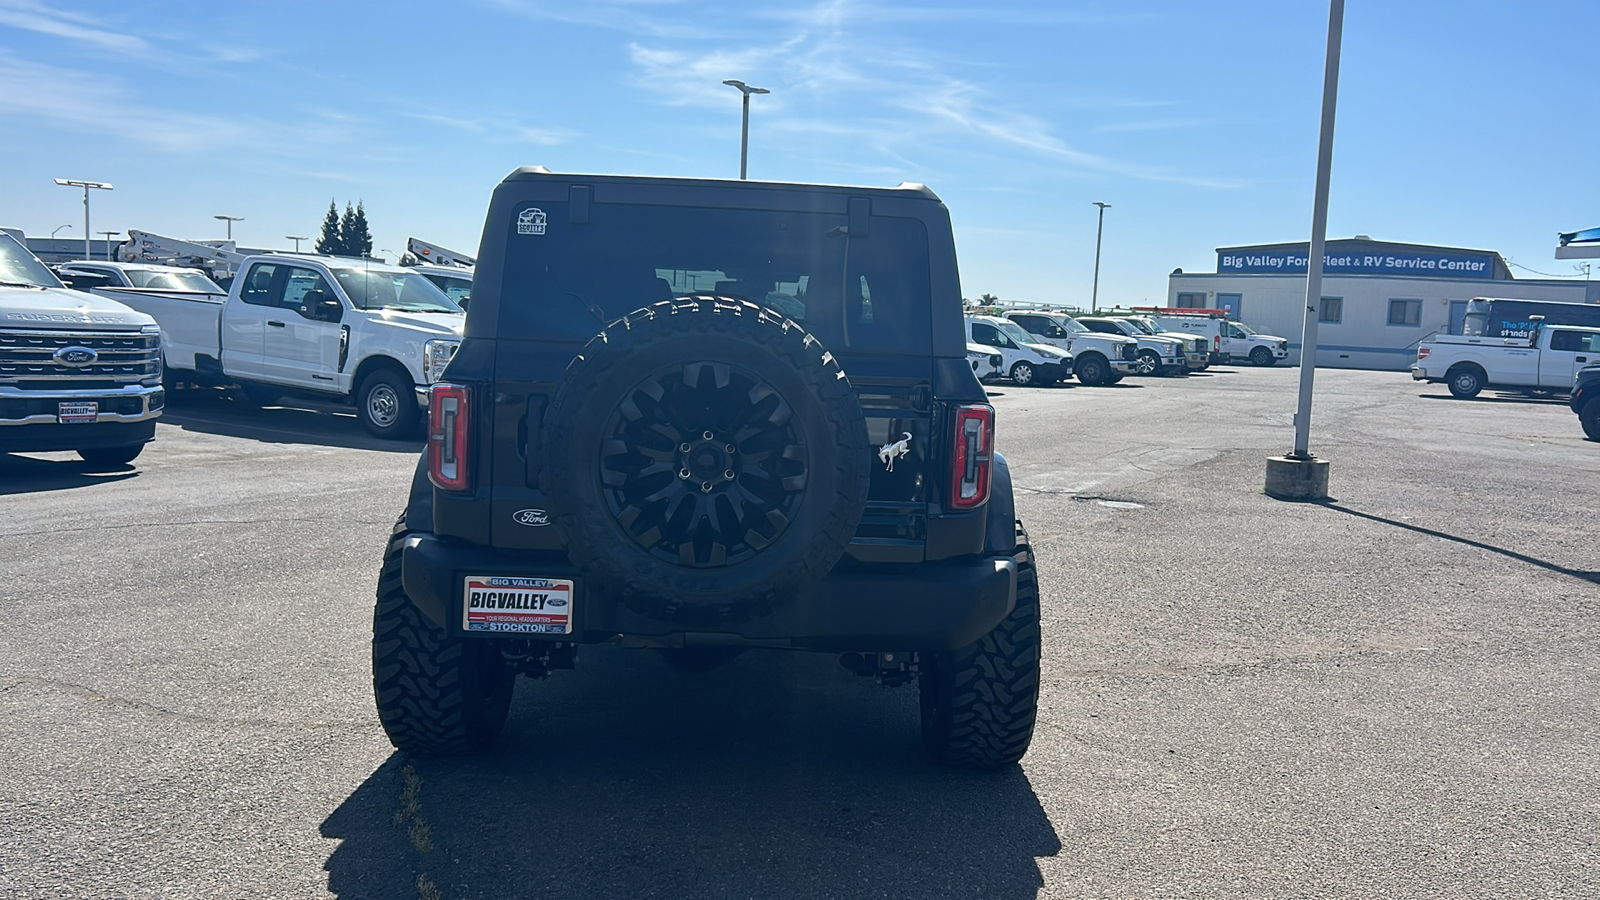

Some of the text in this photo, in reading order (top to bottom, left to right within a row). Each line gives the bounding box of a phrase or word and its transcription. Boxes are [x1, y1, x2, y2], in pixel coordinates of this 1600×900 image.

[1223, 256, 1243, 268] Big
[1246, 256, 1284, 268] Valley
[1286, 256, 1310, 266] For
[1353, 258, 1361, 267] &
[1363, 256, 1383, 267] RV
[1385, 257, 1436, 269] Service
[1438, 259, 1486, 271] Center
[1502, 321, 1516, 329] The
[67, 352, 88, 361] Ford
[521, 511, 548, 523] Ford
[512, 579, 547, 587] VALLEY
[470, 592, 548, 610] BIGVALLEY
[489, 622, 546, 632] STOCKTON
